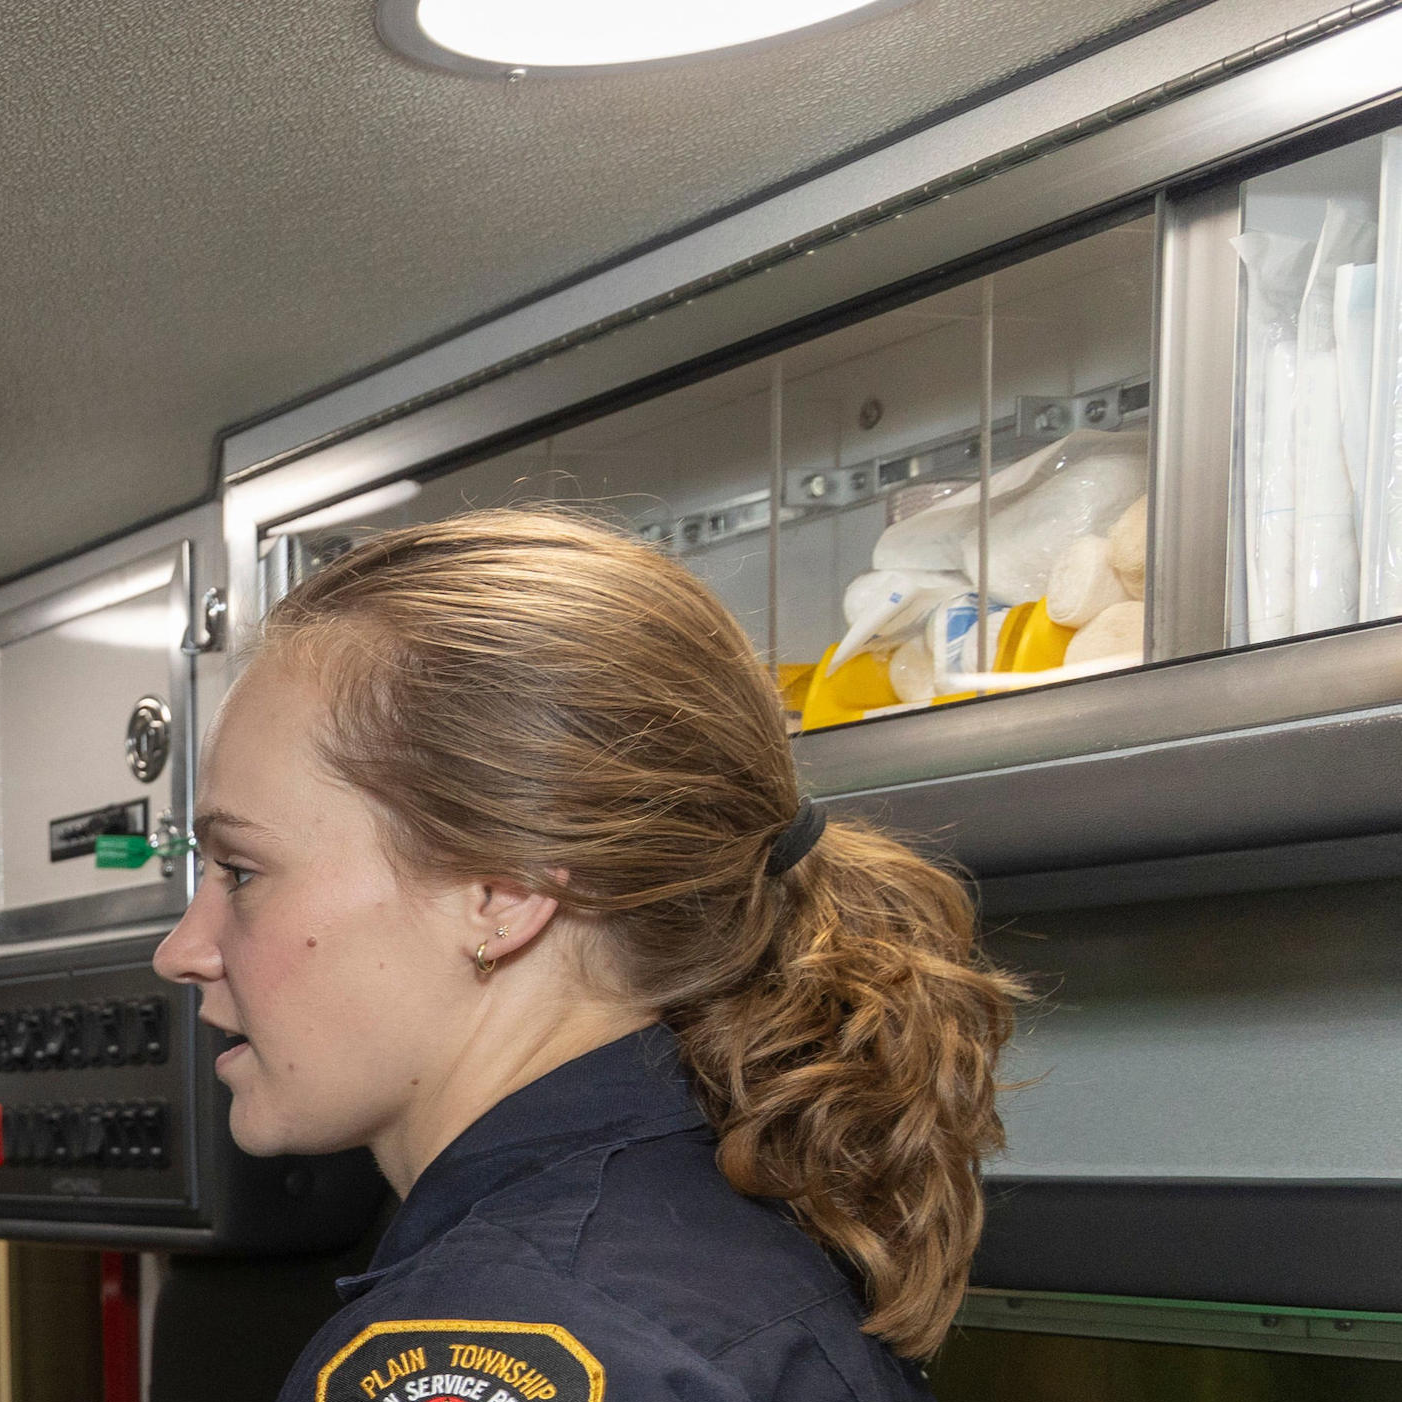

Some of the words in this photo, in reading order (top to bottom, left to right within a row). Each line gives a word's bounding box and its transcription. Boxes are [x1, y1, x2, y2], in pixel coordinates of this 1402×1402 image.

[360, 1347, 427, 1400] PLAIN
[449, 1344, 557, 1401] TOWNSHIP
[405, 1374, 490, 1401] SERVICE
